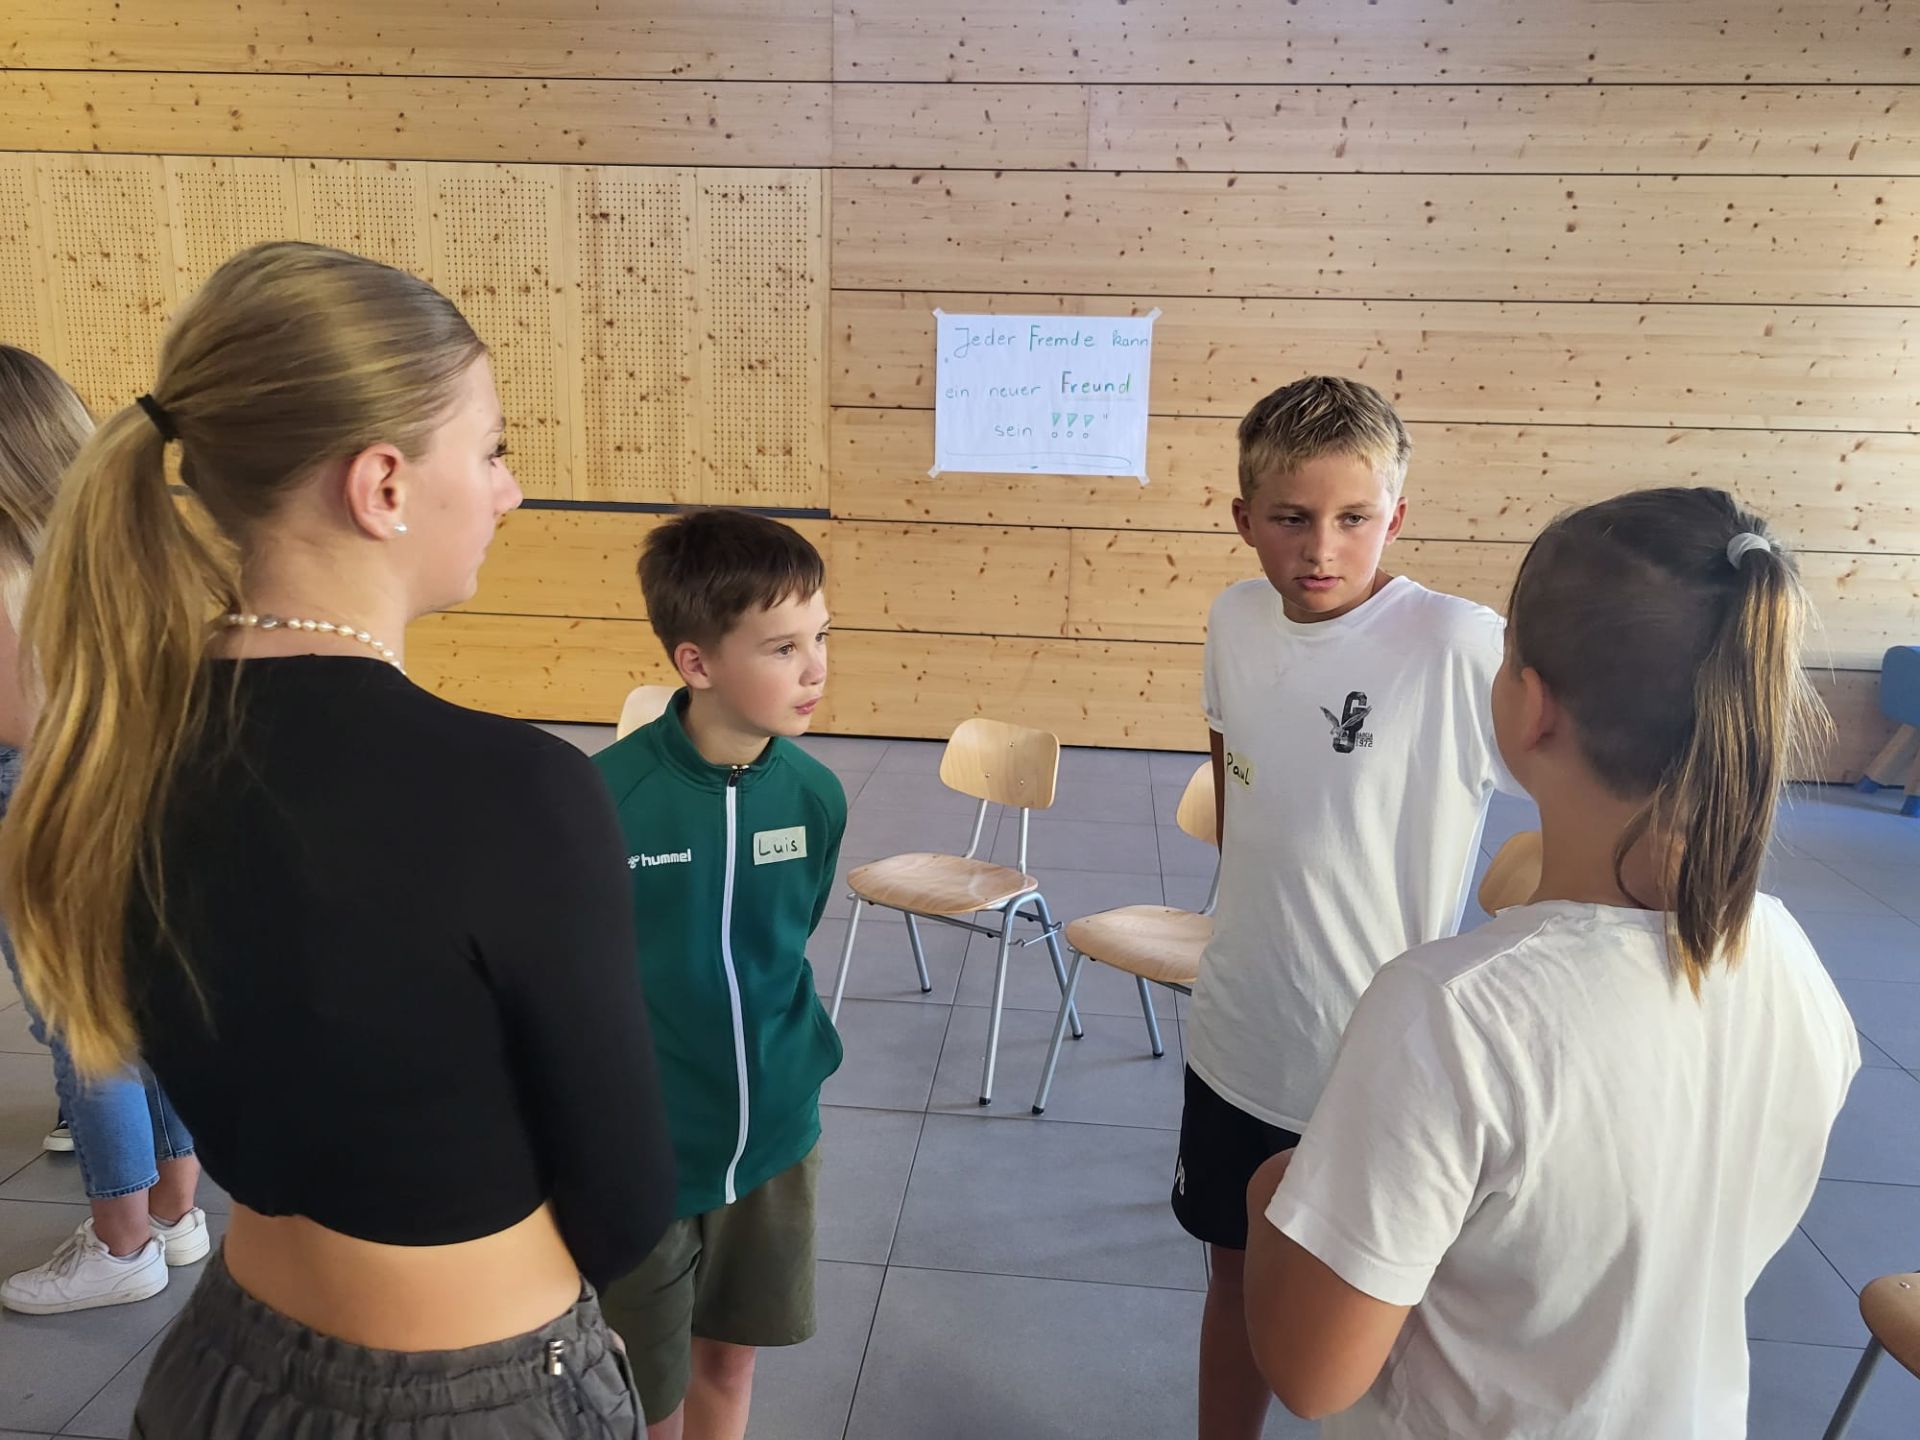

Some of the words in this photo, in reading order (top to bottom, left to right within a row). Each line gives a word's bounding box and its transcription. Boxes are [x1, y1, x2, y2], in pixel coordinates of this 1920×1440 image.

[953, 327, 1017, 359] Jeder
[1029, 325, 1095, 351] Fremde
[1112, 330, 1149, 347] kann
[945, 389, 969, 399] ein
[989, 385, 1041, 398] neuer
[1061, 371, 1132, 395] Freund
[994, 425, 1032, 437] sein
[758, 838, 798, 856] Luis
[641, 849, 692, 867] hummel
